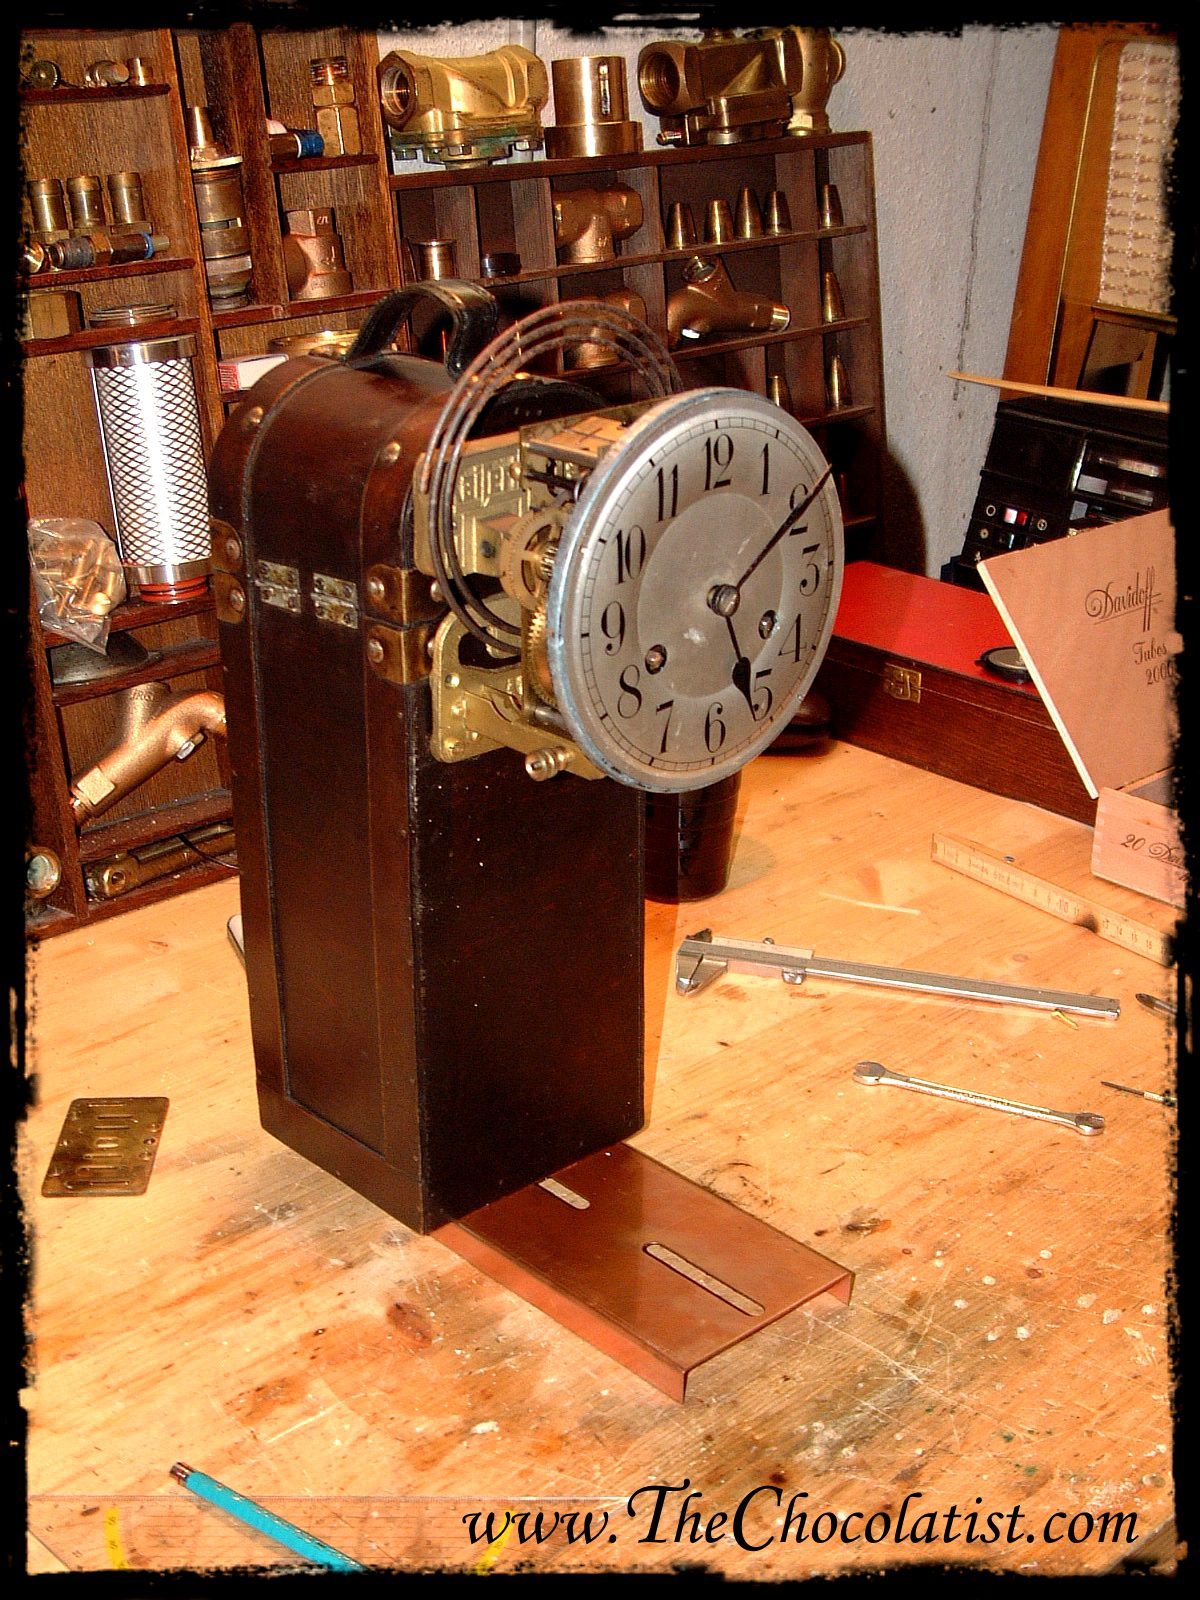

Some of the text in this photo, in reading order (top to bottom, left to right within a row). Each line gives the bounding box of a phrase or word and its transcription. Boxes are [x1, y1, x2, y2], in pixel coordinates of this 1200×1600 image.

[703, 433, 734, 491] 12
[758, 442, 770, 497] 1
[653, 463, 679, 522] 11
[613, 523, 647, 585] 10
[799, 543, 820, 597] 3
[1085, 566, 1164, 633] Davidoff
[600, 600, 626, 656] 9
[778, 613, 802, 663] 4
[1132, 637, 1168, 665] Tubes
[617, 663, 643, 719] 8
[752, 668, 773, 721] 5
[1145, 659, 1176, 685] 2000
[655, 699, 675, 754] 7
[704, 701, 727, 754] 6
[1120, 833, 1146, 851] 20
